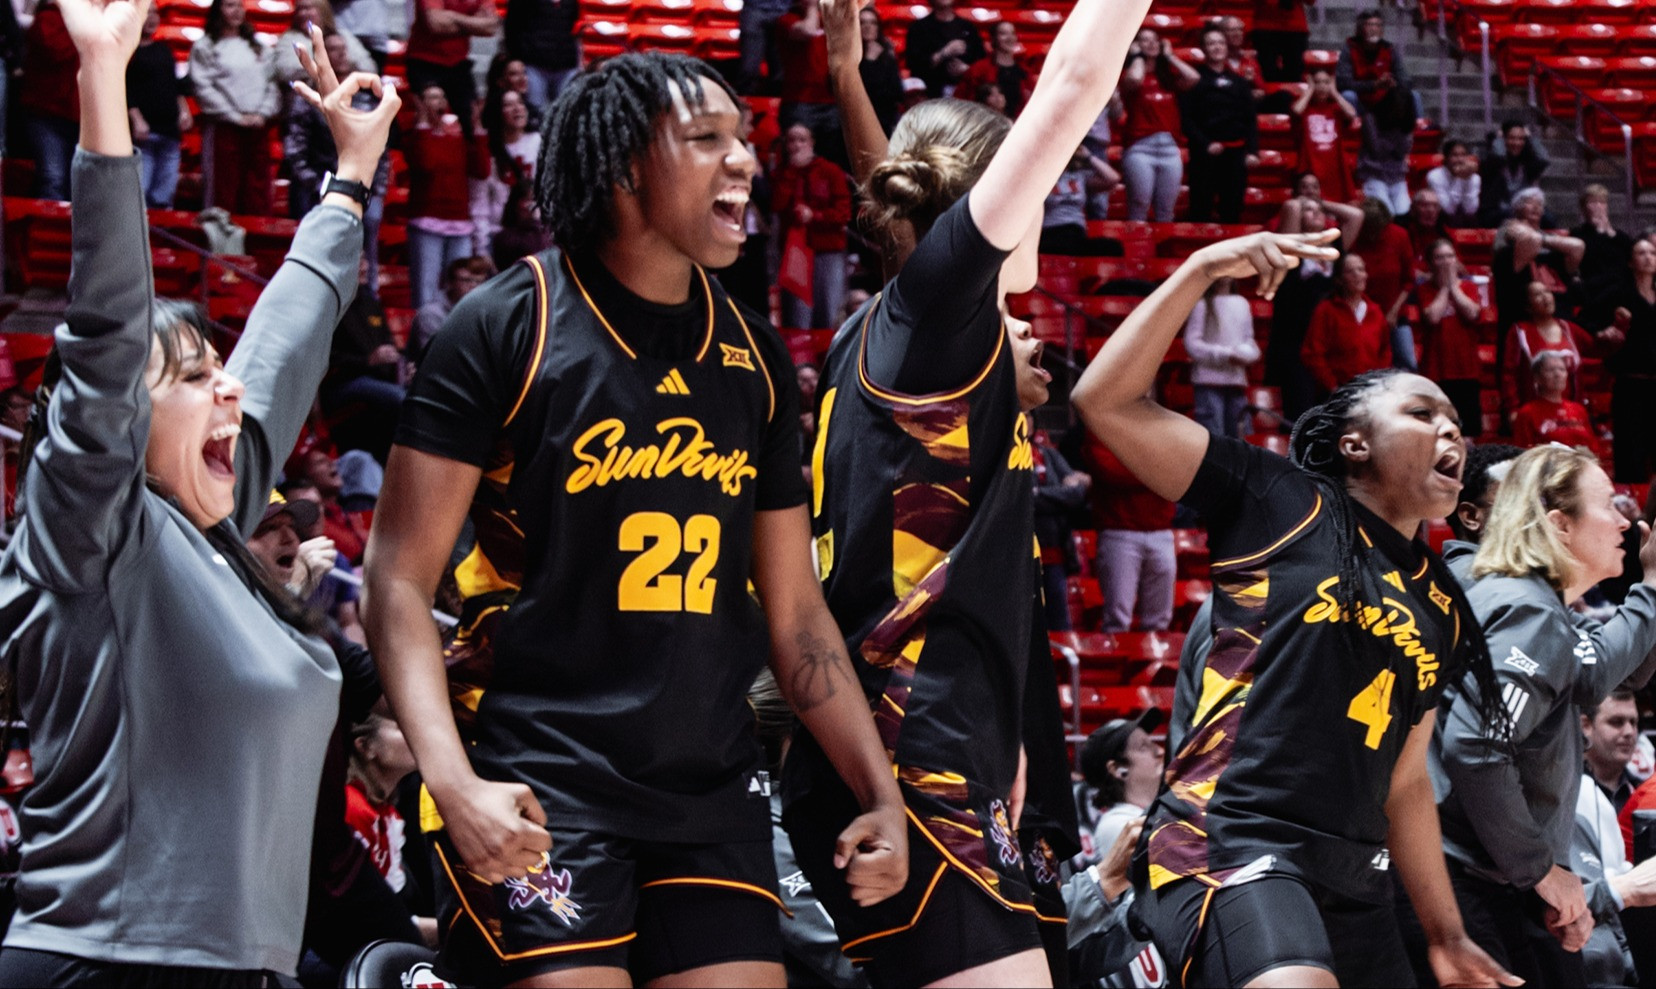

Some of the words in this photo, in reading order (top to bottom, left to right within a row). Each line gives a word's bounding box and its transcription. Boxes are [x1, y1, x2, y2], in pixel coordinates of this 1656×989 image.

[1008, 411, 1034, 471] Su
[618, 511, 721, 615] 22
[1347, 668, 1396, 750] 4
